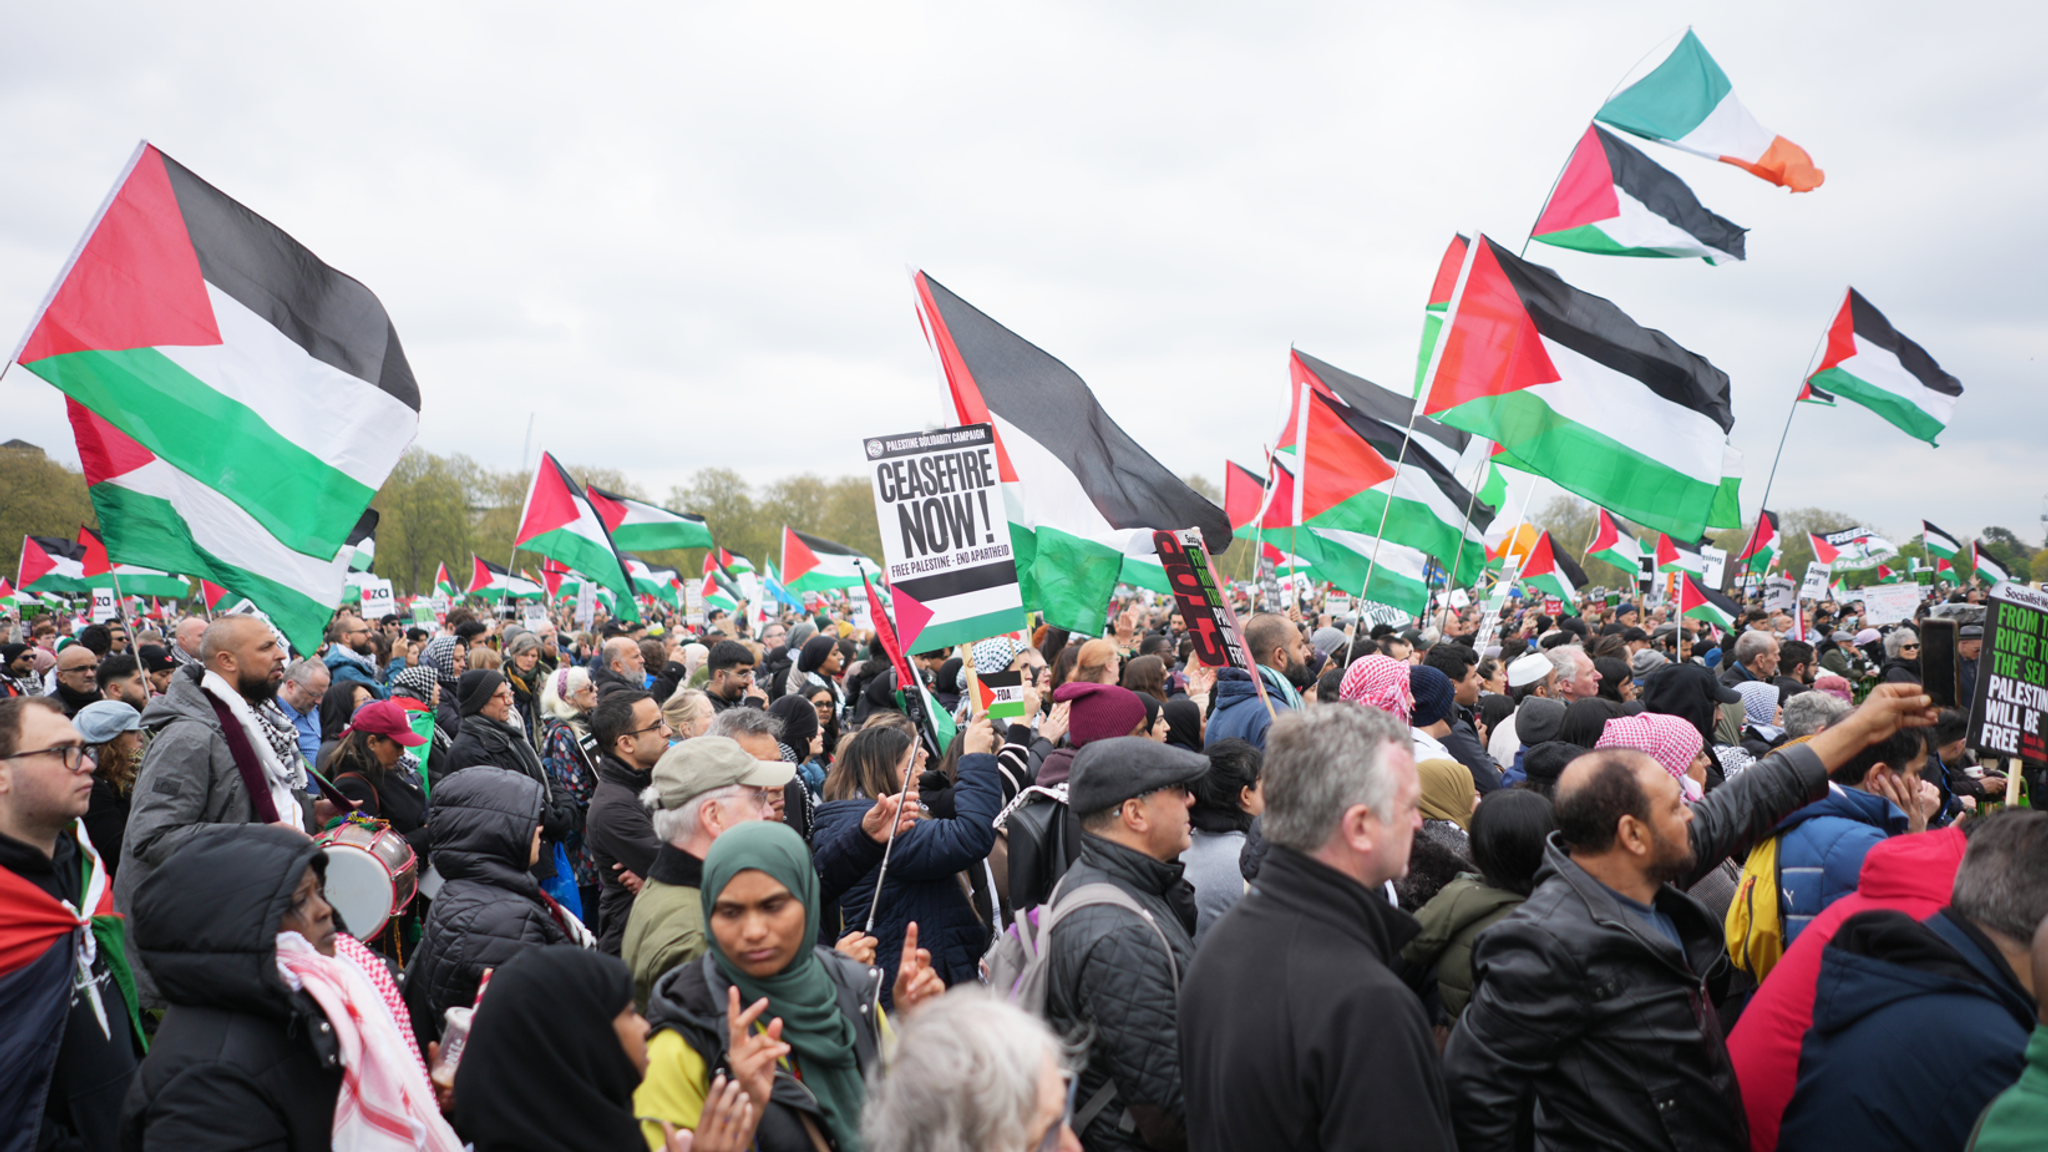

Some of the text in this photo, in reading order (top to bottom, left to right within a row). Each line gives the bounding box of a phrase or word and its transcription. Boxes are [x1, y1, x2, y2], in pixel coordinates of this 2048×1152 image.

[886, 428, 986, 452] PALESTINE SOLIDARITY CAMPAIGN
[877, 448, 996, 503] CEASEFIRE
[897, 489, 995, 560] NOW!
[891, 561, 910, 578] FREE
[911, 555, 951, 574] PALESTINE
[956, 550, 971, 566] END
[971, 544, 1010, 563] APARTHEID
[2005, 586, 2039, 607] Socialist
[1998, 602, 2039, 634] FROM
[1995, 626, 2037, 659] RIVER
[1993, 650, 2045, 686] THE SEA
[997, 688, 1012, 701] FOA
[1986, 698, 2040, 735] WILL BE
[1981, 722, 2020, 754] FREE
